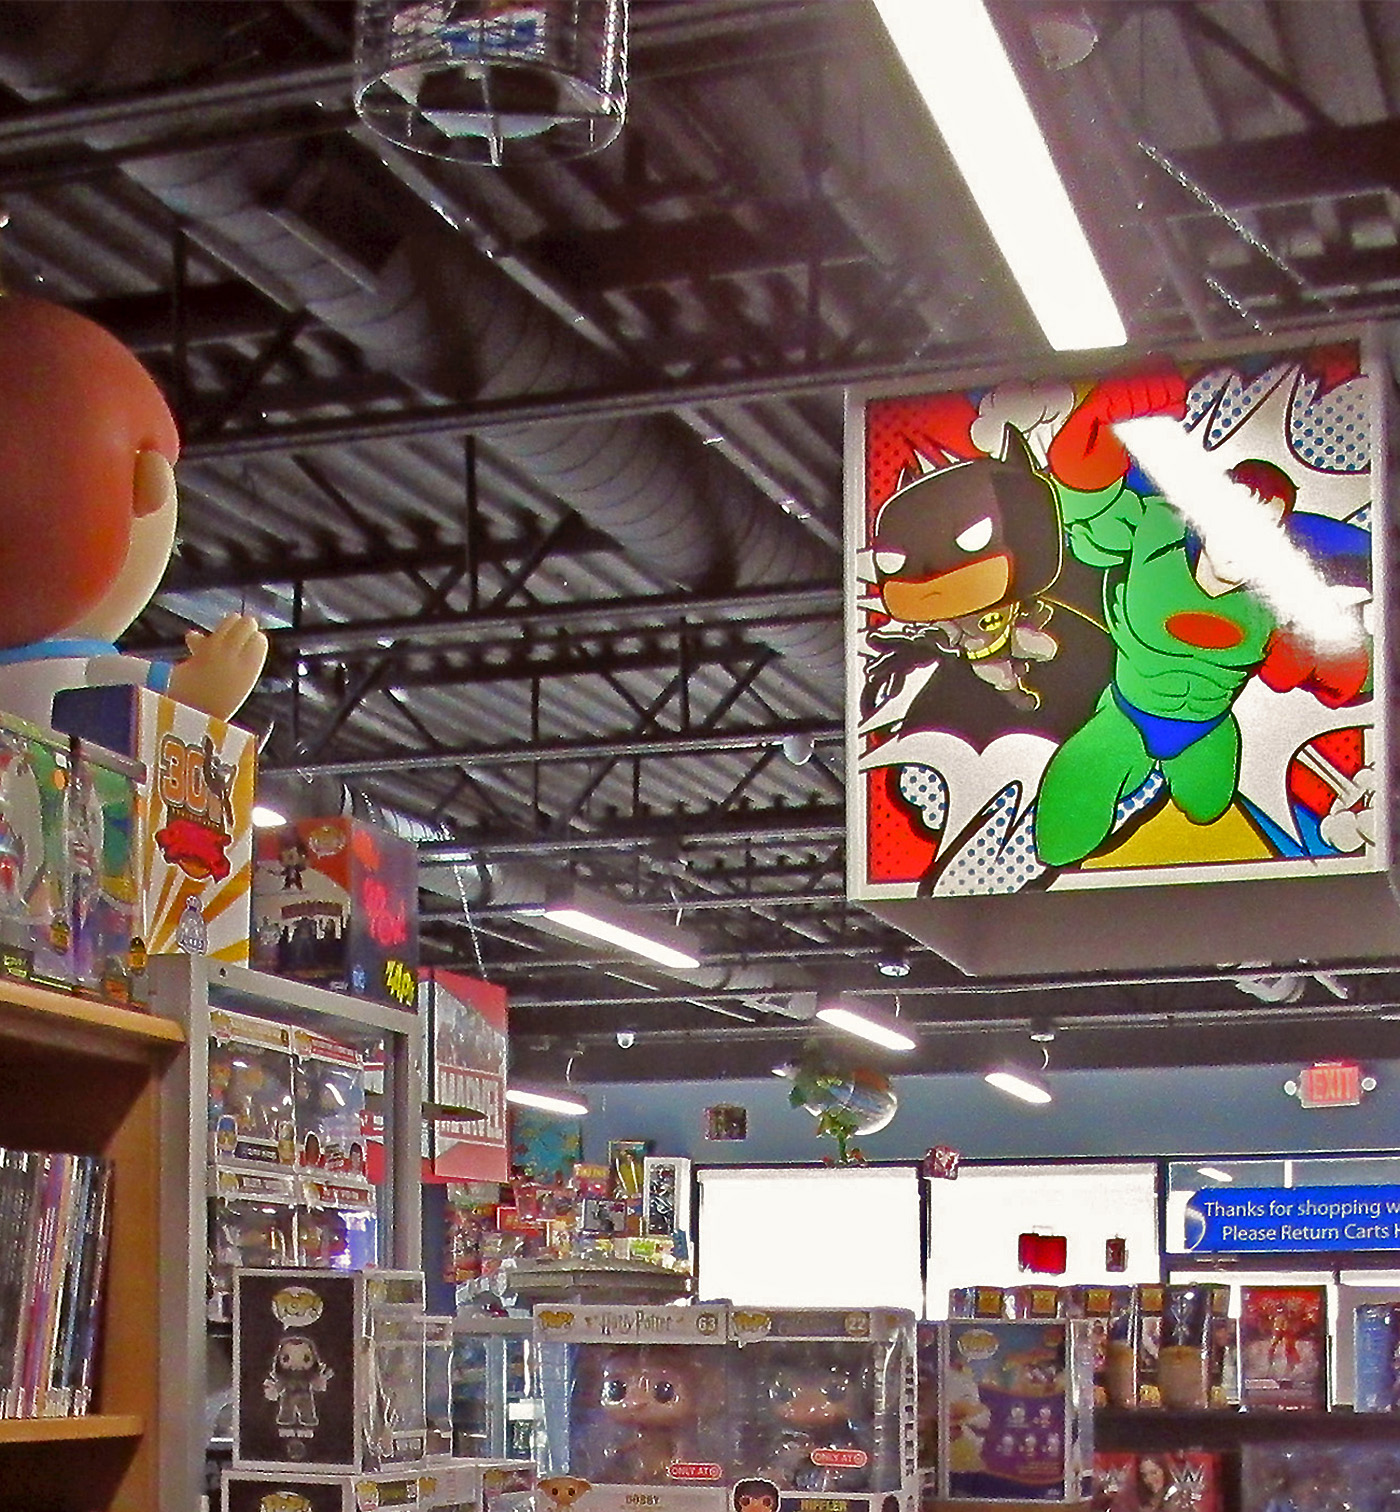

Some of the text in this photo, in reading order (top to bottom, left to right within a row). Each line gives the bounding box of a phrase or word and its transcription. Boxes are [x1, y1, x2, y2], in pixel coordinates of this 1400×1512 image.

[1311, 1068, 1352, 1099] EXIT
[1204, 1201, 1265, 1217] Thanks
[1269, 1200, 1292, 1216] for
[1297, 1200, 1381, 1222] shopping
[1222, 1225, 1276, 1240] Please
[1281, 1224, 1339, 1240] Return
[1344, 1223, 1390, 1239] Carts
[635, 1310, 674, 1336] Potter
[700, 1316, 718, 1331] 63
[848, 1316, 867, 1331] 22
